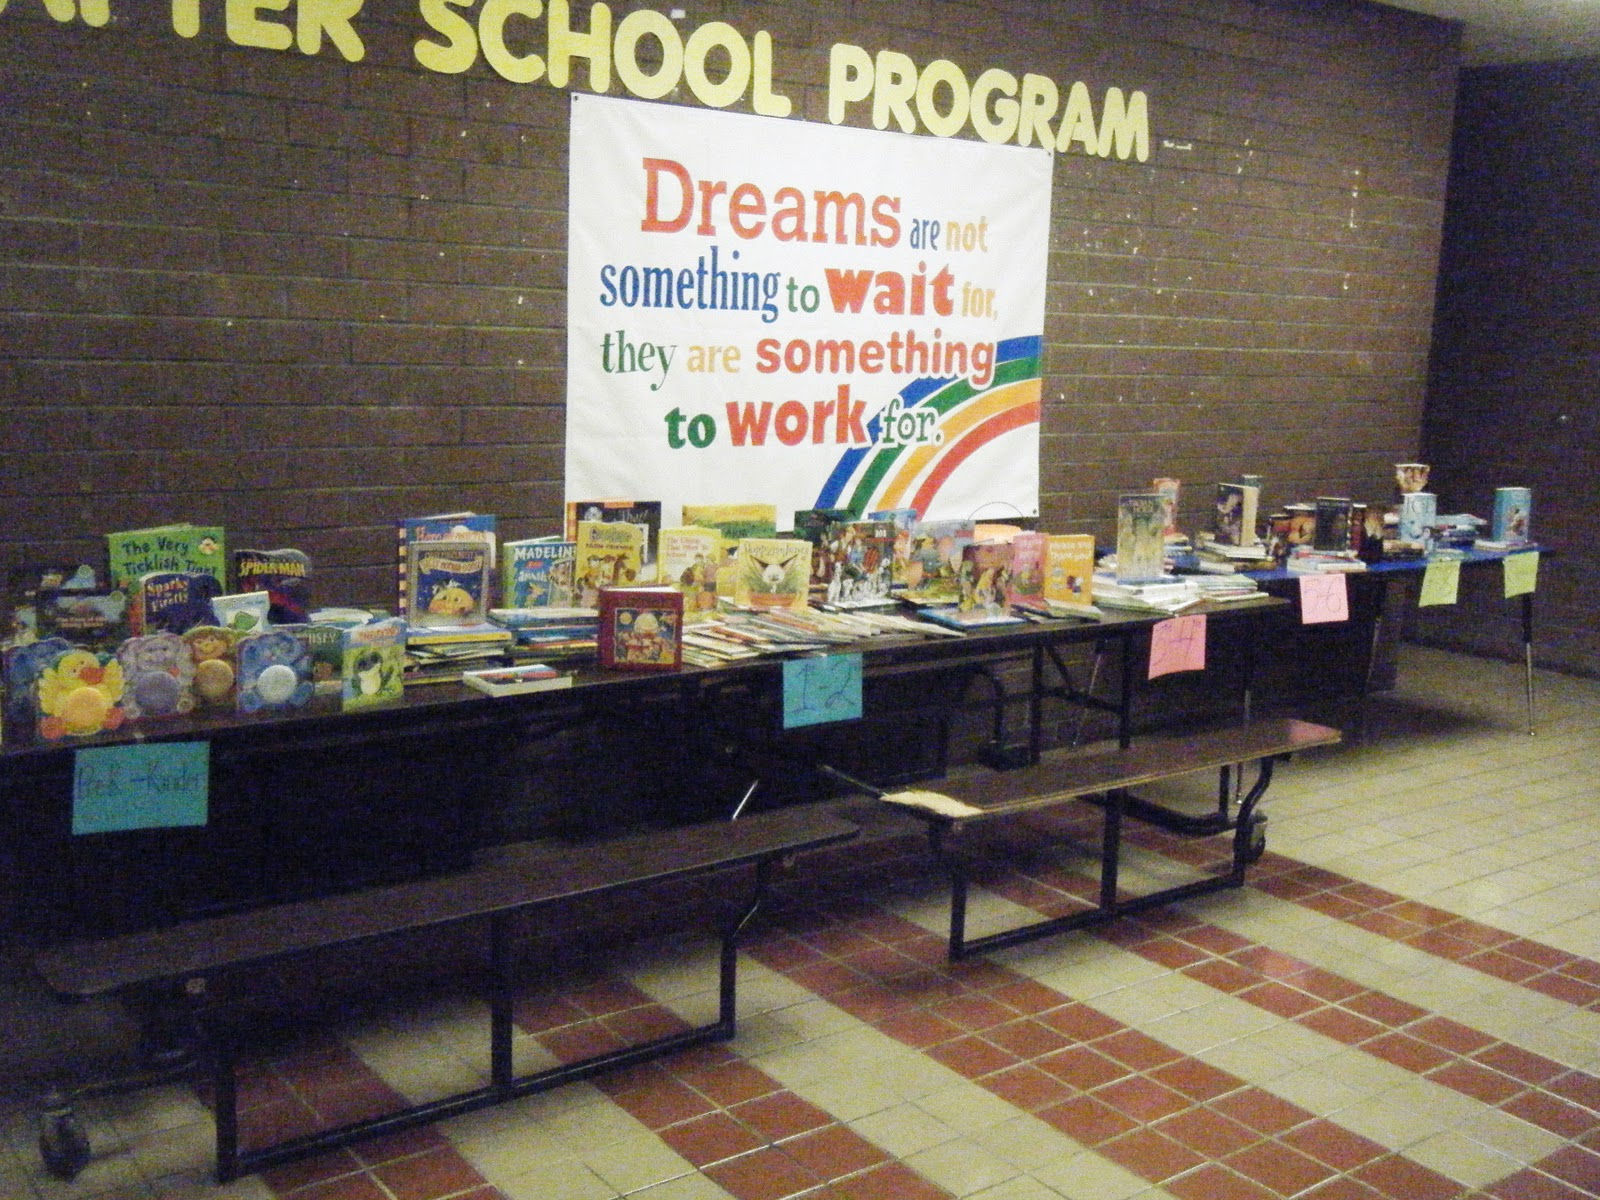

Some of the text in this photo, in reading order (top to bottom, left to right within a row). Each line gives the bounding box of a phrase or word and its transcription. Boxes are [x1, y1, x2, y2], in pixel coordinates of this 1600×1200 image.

[413, 0, 792, 117] SCHOOL
[829, 43, 1149, 163] PROGRAM
[641, 157, 988, 252] Dreams are not
[600, 245, 998, 323] something to wait for,
[600, 328, 994, 390] they are something
[664, 383, 942, 449] to work for.
[122, 536, 189, 556] The Very
[123, 553, 180, 575] Ticklish
[513, 545, 577, 560] MADELIN
